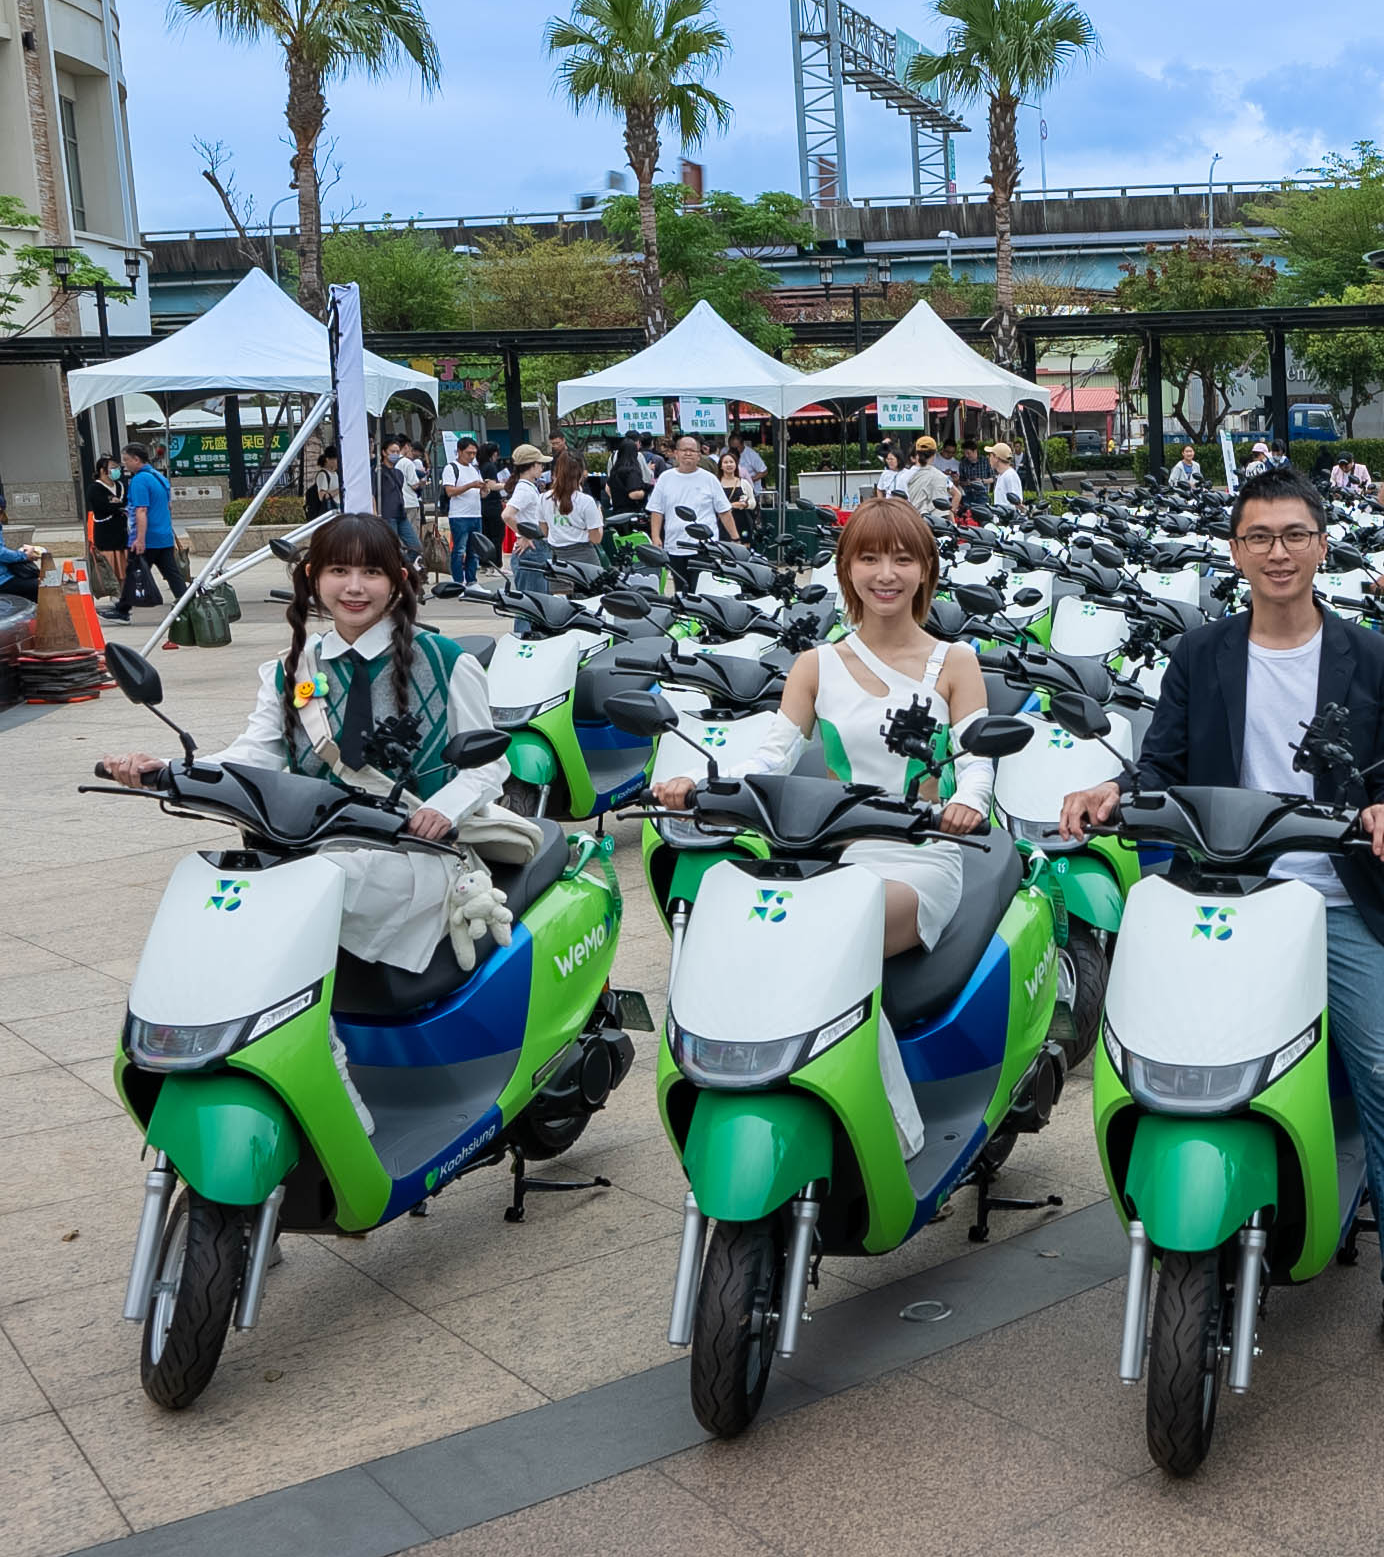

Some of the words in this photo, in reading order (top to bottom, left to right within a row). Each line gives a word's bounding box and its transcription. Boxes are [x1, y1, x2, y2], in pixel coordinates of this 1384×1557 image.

[889, 413, 913, 422] 報到區
[691, 419, 716, 428] 報到區
[440, 1123, 496, 1179] Kaohsiung
